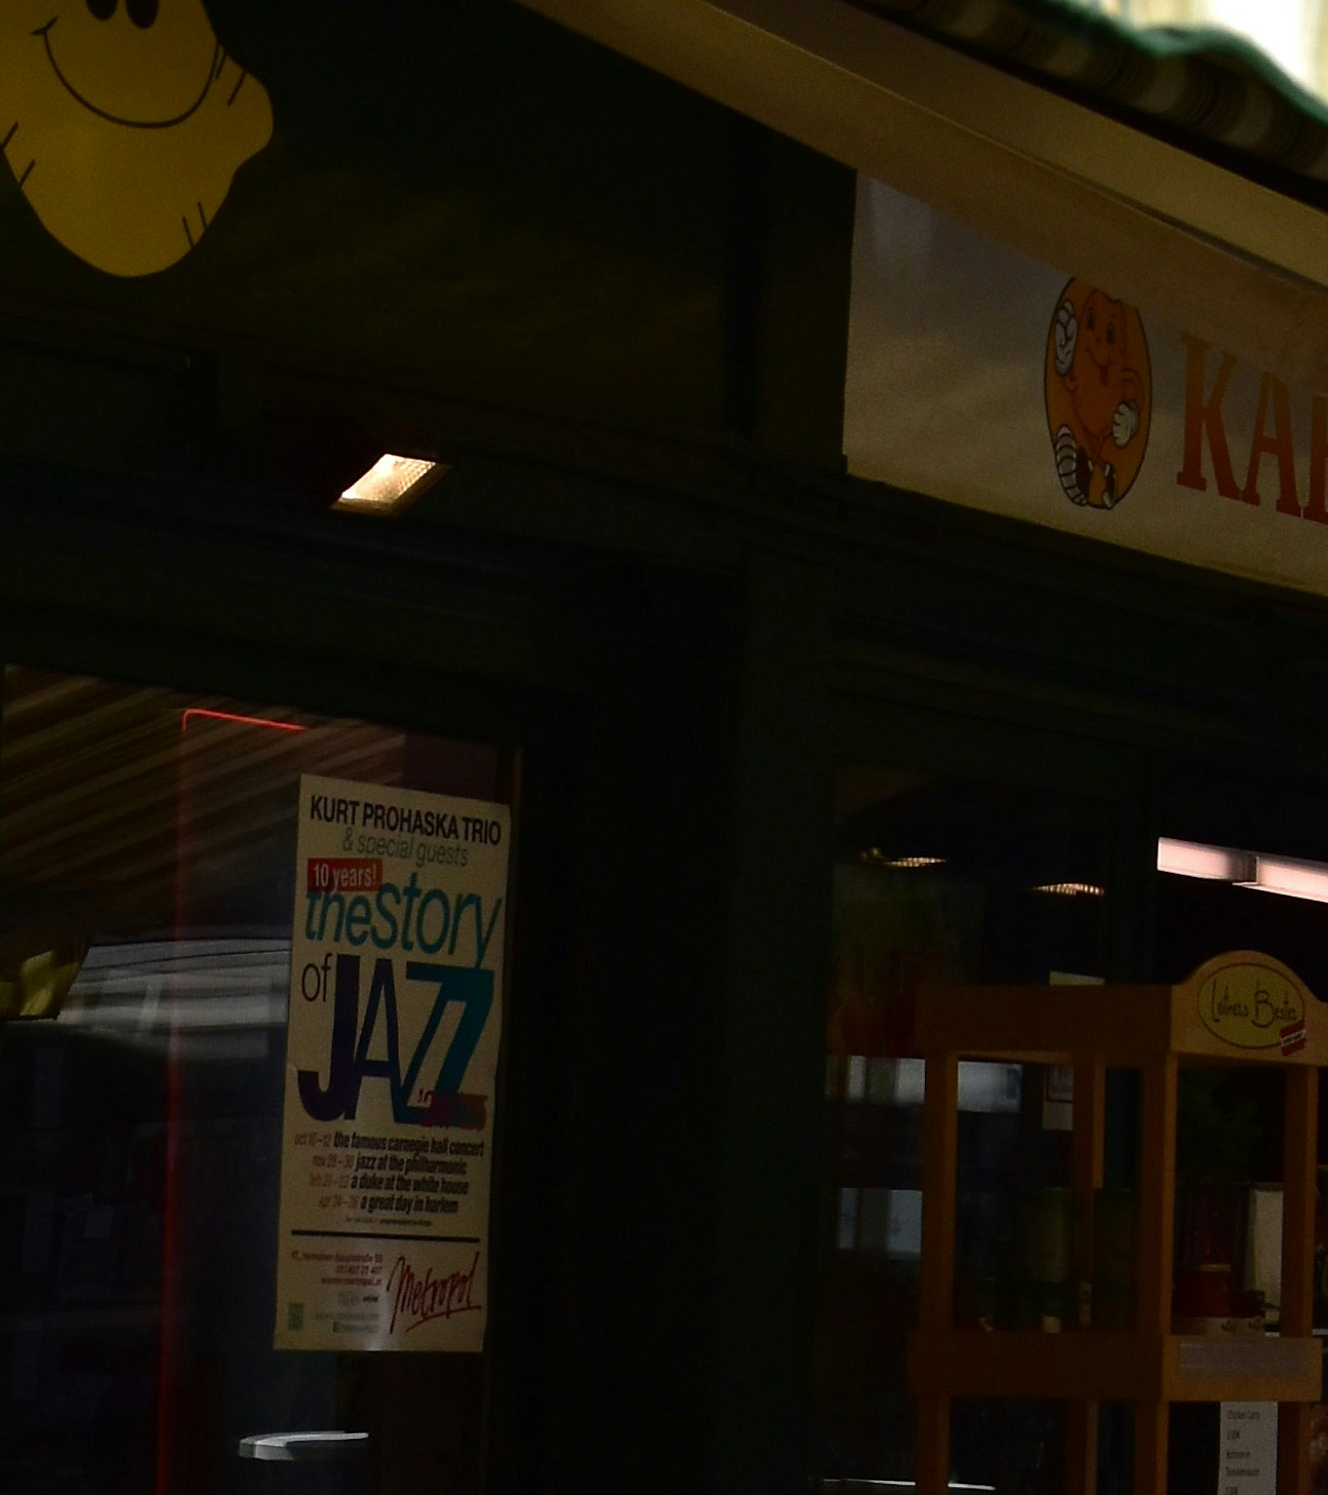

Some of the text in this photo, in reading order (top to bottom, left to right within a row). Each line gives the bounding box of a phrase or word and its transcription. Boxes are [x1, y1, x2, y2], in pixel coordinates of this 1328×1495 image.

[310, 795, 502, 845] KURT PROHASKA TRIO
[342, 827, 468, 867] & special guests
[313, 863, 378, 892] 10 years!
[297, 953, 495, 1126] of JAZZ
[334, 1131, 350, 1148] the
